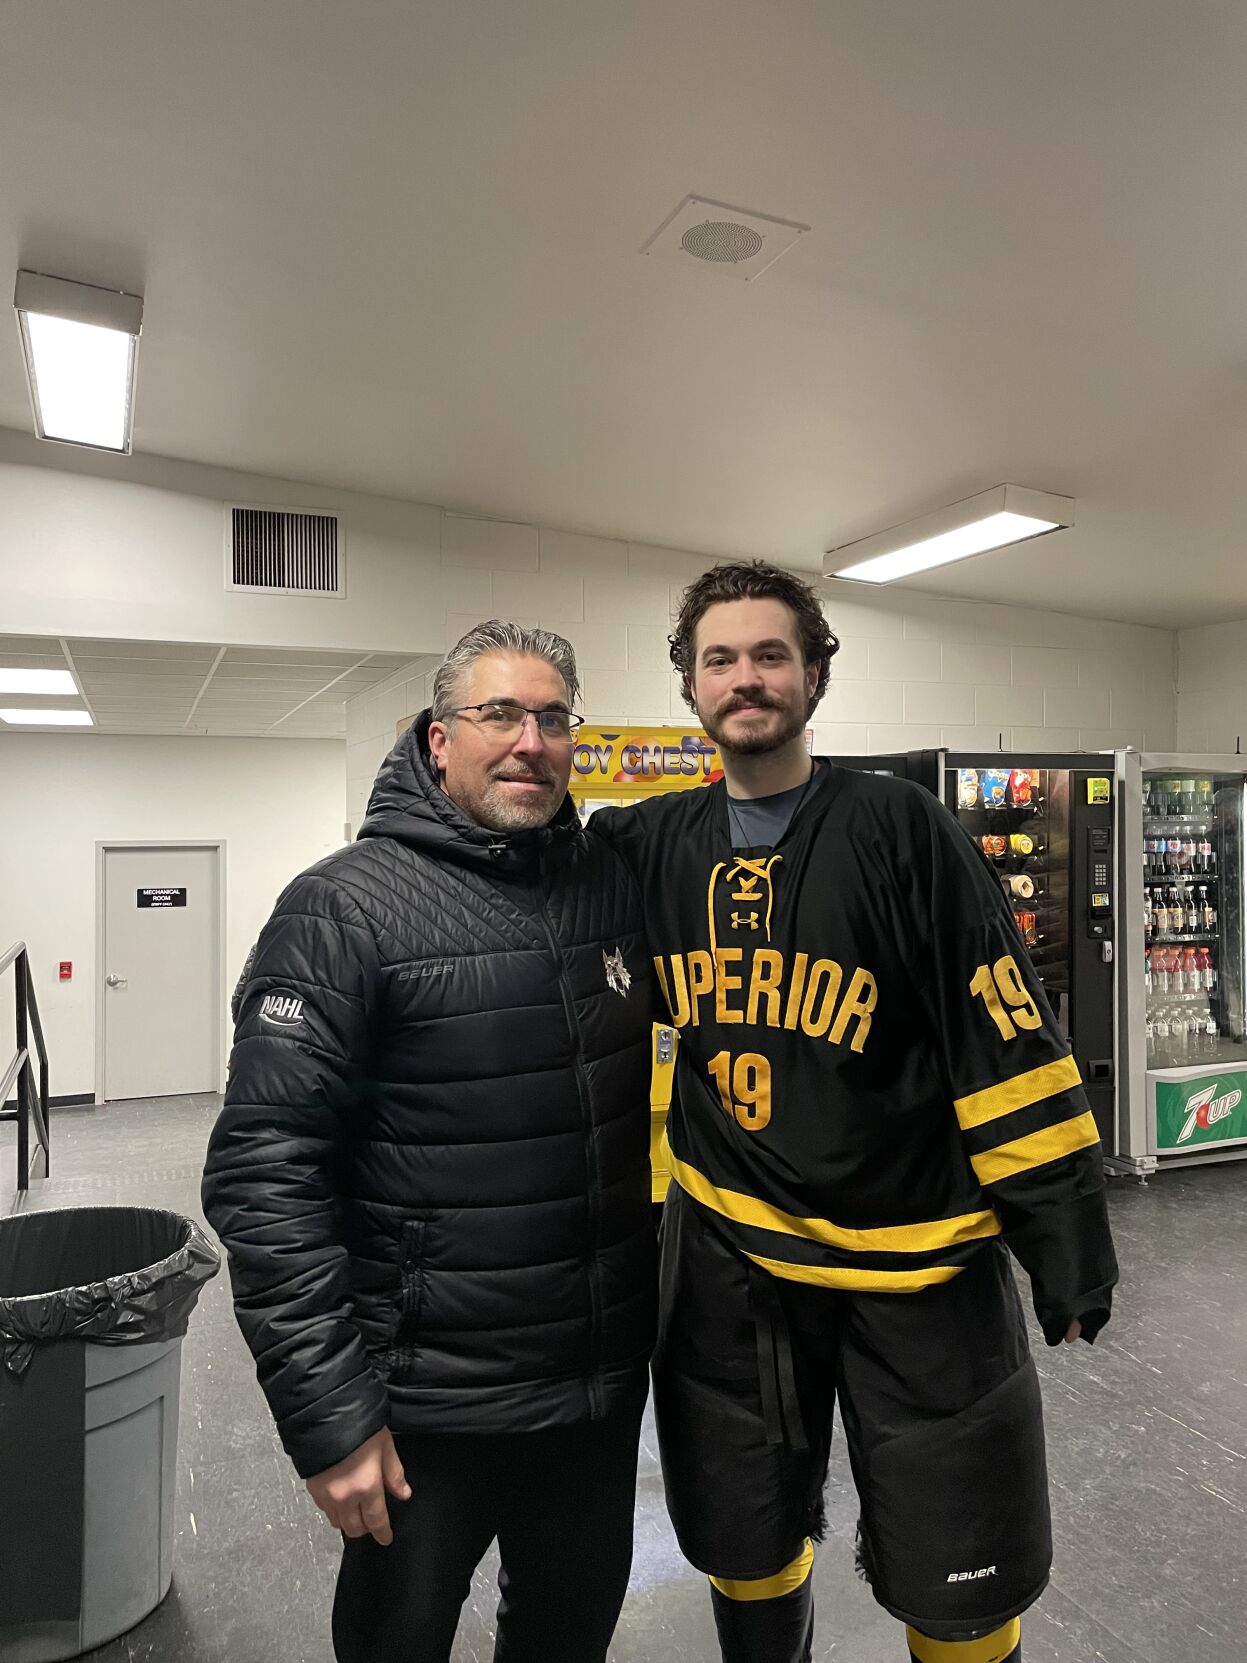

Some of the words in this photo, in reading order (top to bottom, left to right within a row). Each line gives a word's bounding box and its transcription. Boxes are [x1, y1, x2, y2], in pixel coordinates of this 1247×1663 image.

[573, 744, 613, 775] OY
[621, 745, 717, 776] CHEST
[397, 964, 454, 981] BAUER
[259, 995, 304, 1019] NAHL
[653, 947, 878, 1054] UPERIOR
[969, 955, 1043, 1041] 19
[707, 1050, 772, 1131] 19
[946, 1565, 998, 1583] BAUER
